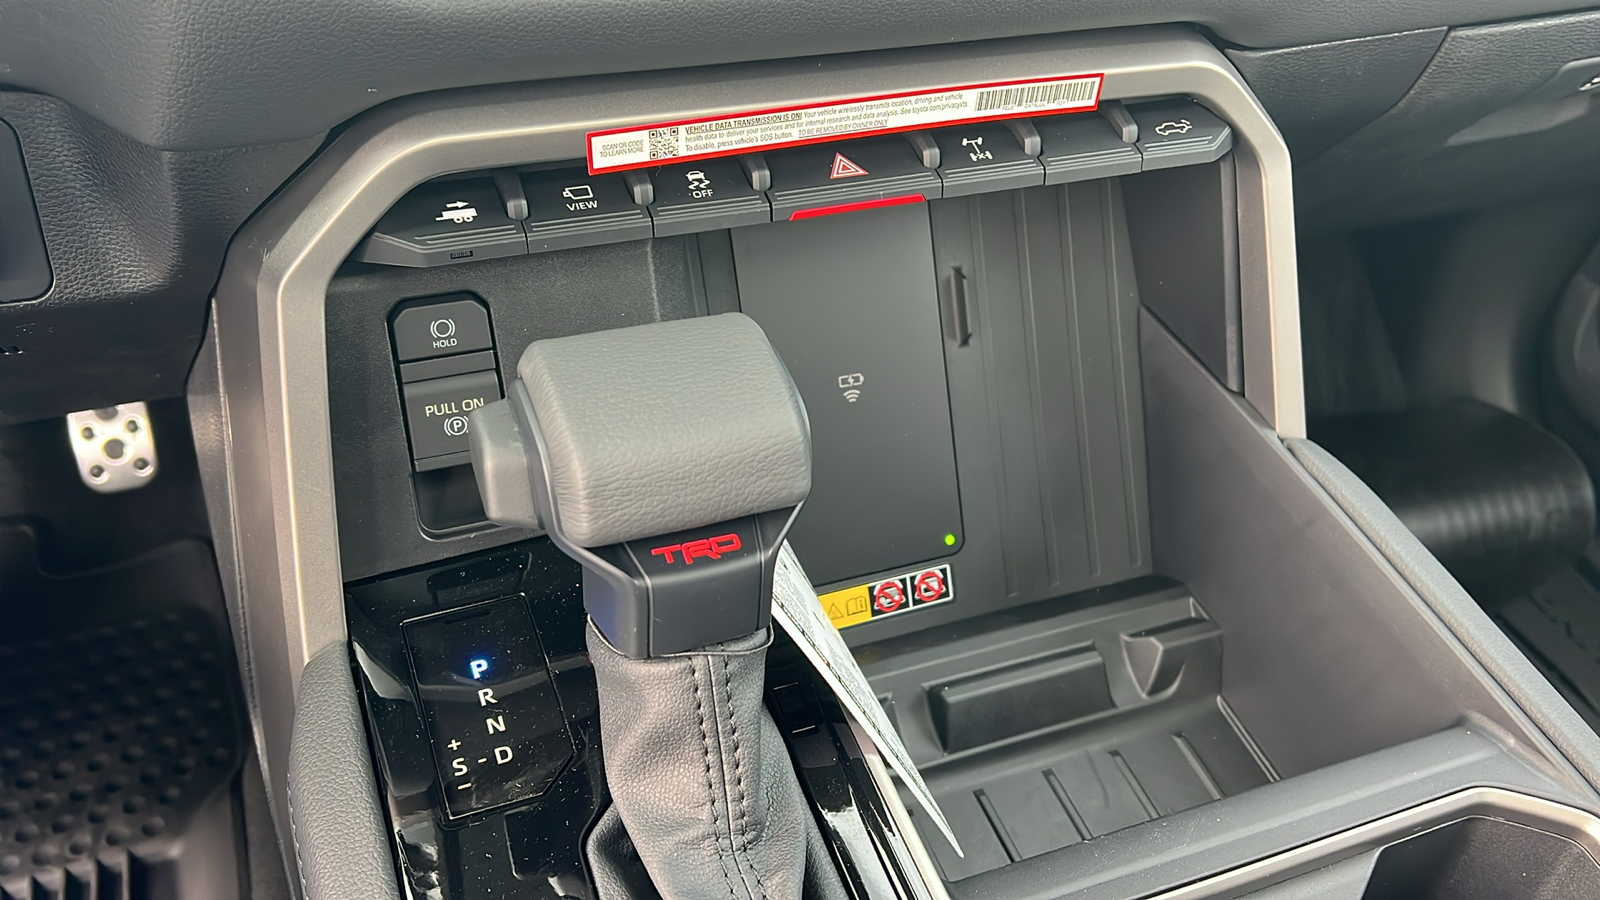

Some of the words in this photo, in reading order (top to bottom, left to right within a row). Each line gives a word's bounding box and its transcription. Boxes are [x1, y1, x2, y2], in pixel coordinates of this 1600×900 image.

[685, 124, 713, 133] VEHICLE
[715, 121, 731, 130] DATA
[734, 115, 782, 127] TRANSMISSION
[818, 108, 836, 117] vehicle
[838, 105, 864, 115] wirelessly
[866, 102, 890, 111] transmits
[891, 99, 913, 109] location,
[914, 97, 931, 106] driving
[945, 93, 963, 101] vehicle
[686, 134, 703, 143] health
[726, 129, 744, 137] deliver
[747, 127, 758, 136] your
[760, 124, 783, 133] services
[805, 119, 825, 127] internal
[827, 116, 850, 124] research
[863, 112, 874, 120] data
[876, 109, 899, 119] analysis.
[816, 125, 843, 134] REMOVED
[852, 121, 873, 129] OWNER
[602, 143, 618, 151] SCAN
[694, 142, 716, 152] disable,
[718, 139, 733, 148] press
[735, 136, 758, 145] vehicle's
[775, 131, 793, 139] button.
[692, 189, 713, 199] OFF
[566, 200, 598, 211] VIEW
[433, 338, 457, 348] HOLD
[425, 402, 459, 417] PULL
[462, 397, 484, 411] ON
[453, 420, 462, 432] P
[651, 533, 741, 564] TRD
[470, 660, 488, 679] P
[478, 688, 498, 706] R
[486, 715, 506, 734] N
[452, 757, 468, 776] S
[494, 746, 513, 764] D
